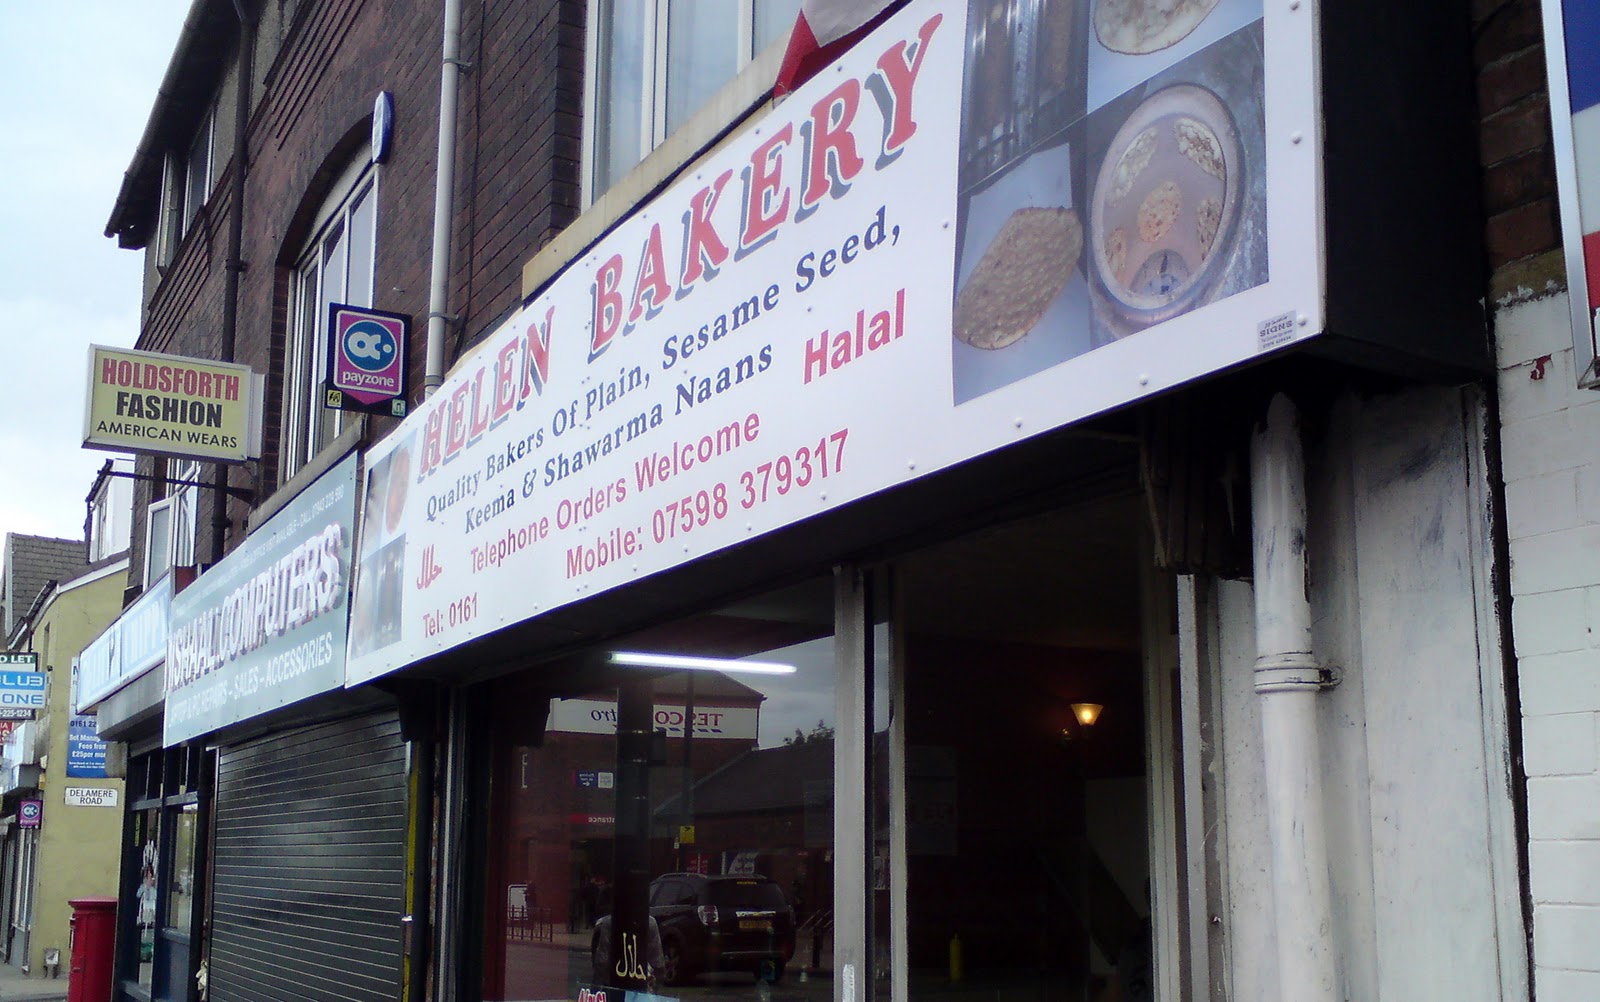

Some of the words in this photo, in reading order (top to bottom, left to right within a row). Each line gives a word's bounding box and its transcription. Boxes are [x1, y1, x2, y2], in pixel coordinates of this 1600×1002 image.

[417, 305, 555, 484] HELEN
[587, 13, 943, 365] BAKERY
[1260, 320, 1293, 337] SIGNS
[102, 357, 239, 401] HOLDSFORTH
[342, 371, 394, 387] payzone
[426, 468, 482, 521] Quality
[485, 426, 545, 482] Bakers
[552, 399, 578, 437] Of
[585, 364, 650, 421] Plain,
[663, 283, 780, 370] Sesame
[795, 205, 901, 293] Seed,
[116, 391, 222, 428] FASHION
[465, 488, 515, 535] Keema
[522, 471, 537, 499] &
[544, 403, 664, 488] Shawarma
[674, 343, 773, 416] Naans
[803, 287, 906, 385] Halal
[97, 420, 182, 442] AMERICAN
[187, 431, 237, 448] WEARS
[471, 515, 549, 575] Telephone
[556, 476, 627, 531] Orders
[634, 412, 761, 493] Welcome
[566, 524, 643, 580] Mobile:
[652, 481, 728, 545] 07598
[740, 427, 849, 511] 379317
[220, 524, 342, 662] COMPUTERS
[422, 613, 444, 638] Tel:
[449, 592, 478, 628] 0161
[11, 655, 33, 663] LET
[234, 666, 259, 700] SALES
[265, 631, 333, 688] ACCESSORIES
[70, 789, 113, 797] DELAMERE
[79, 796, 103, 805] ROAD
